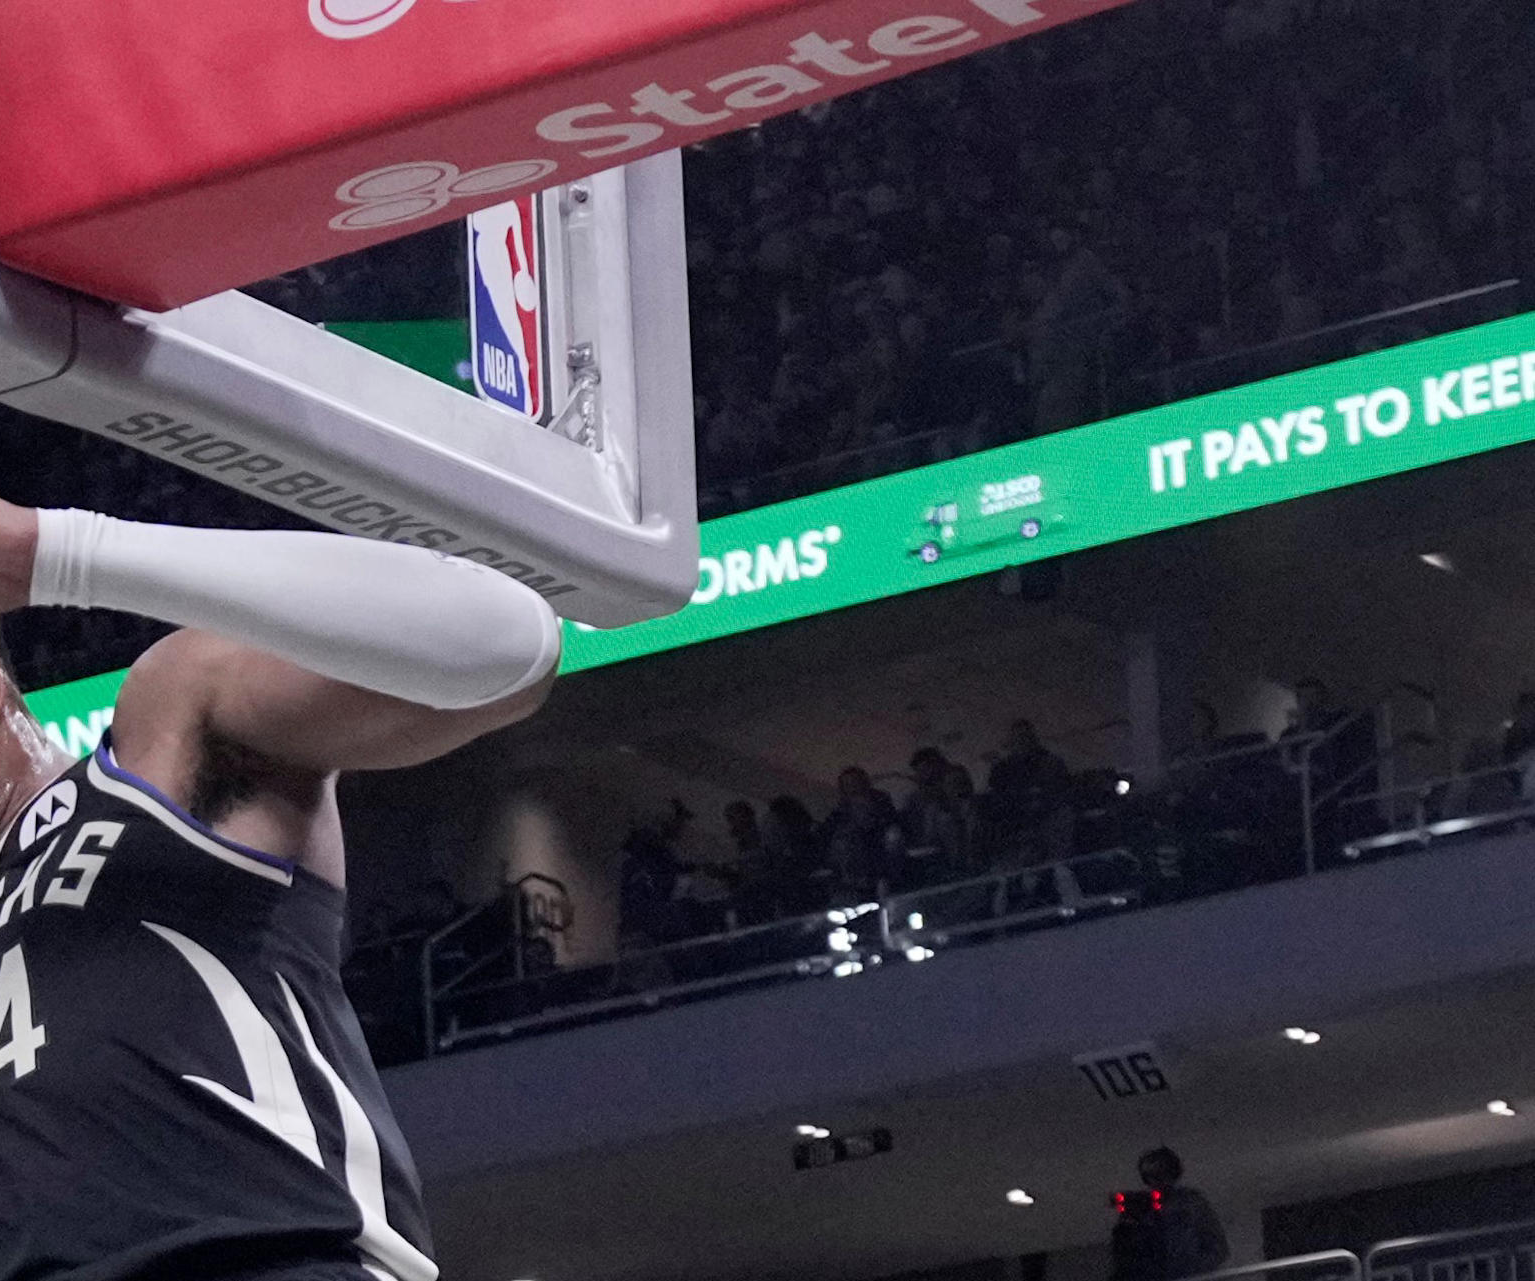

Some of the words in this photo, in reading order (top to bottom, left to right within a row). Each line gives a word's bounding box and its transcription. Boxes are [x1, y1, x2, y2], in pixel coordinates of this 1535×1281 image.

[535, 0, 1046, 158] State
[483, 342, 517, 398] NBA
[1149, 438, 1193, 493] IT
[1202, 405, 1328, 480] PAYS
[1335, 386, 1411, 446] TO
[105, 410, 580, 600] SHOP.BUCKSOM
[1078, 1051, 1169, 1101] 106
